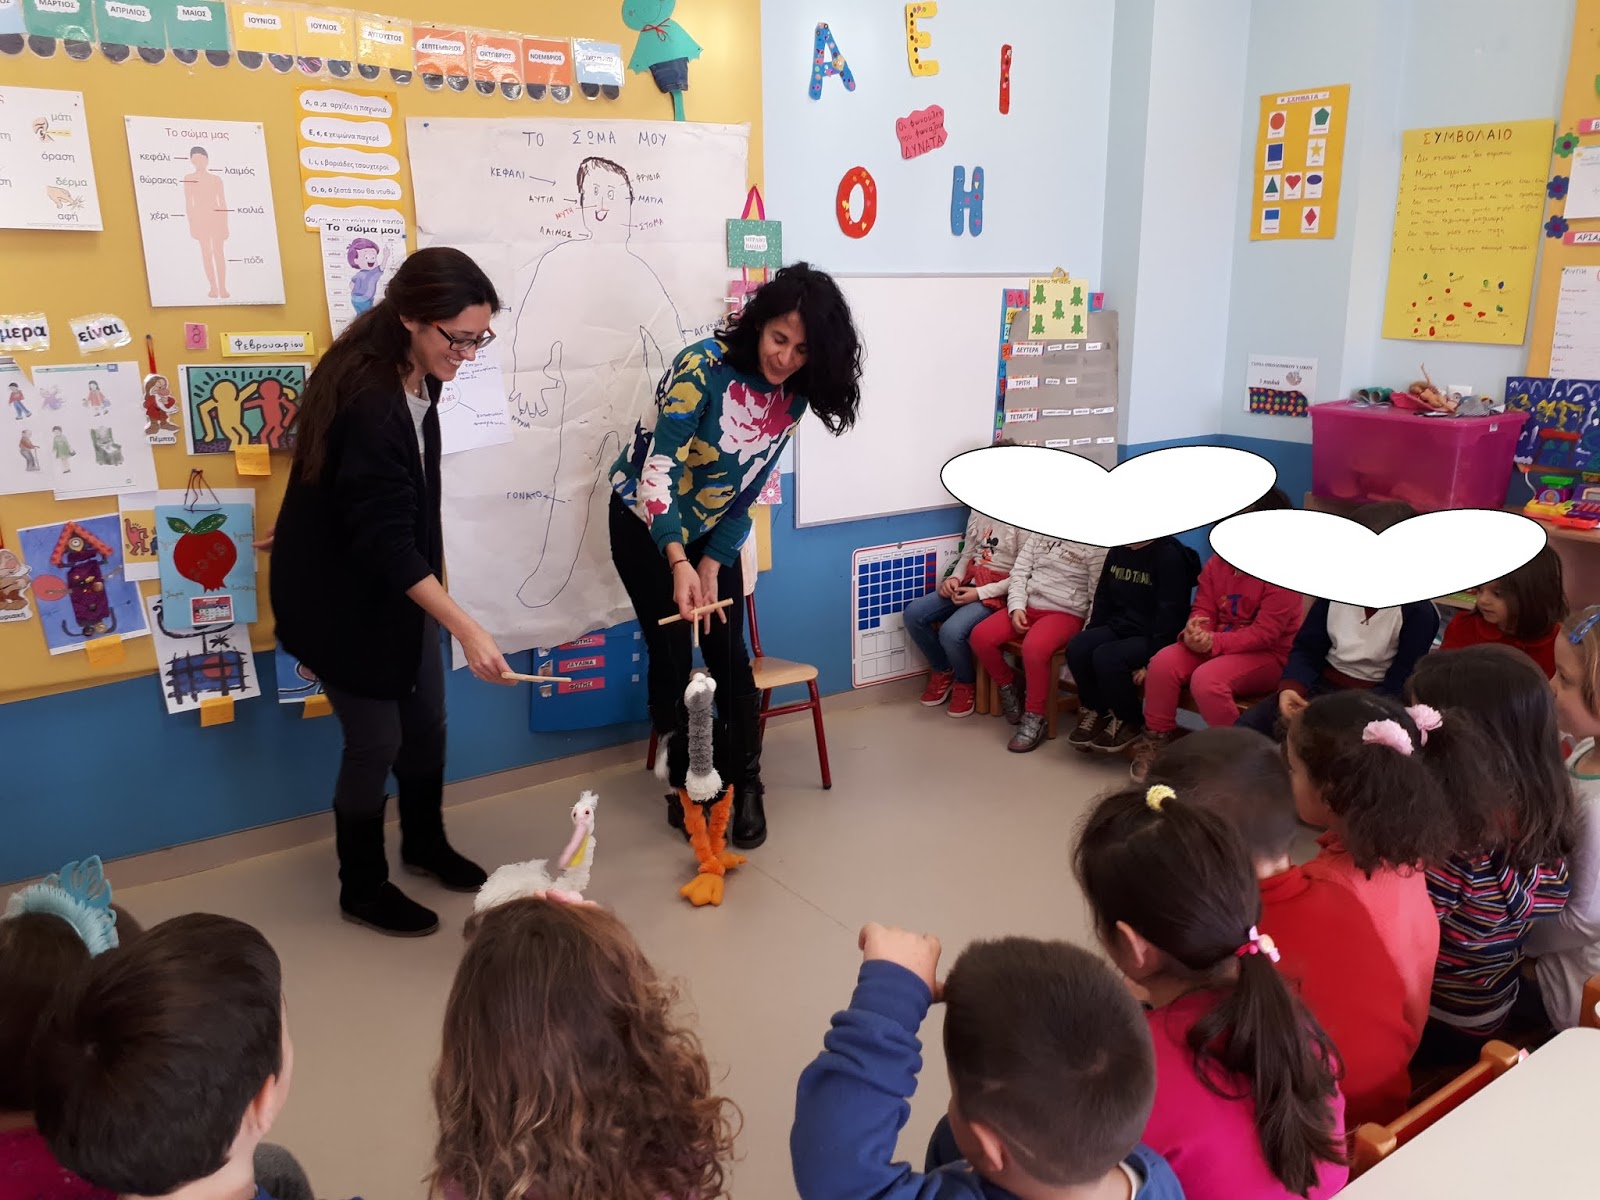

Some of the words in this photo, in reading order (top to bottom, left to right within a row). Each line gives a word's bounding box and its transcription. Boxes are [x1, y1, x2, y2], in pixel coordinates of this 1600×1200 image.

[110, 6, 147, 17] ΑΠΡΙΛΙΟΣ
[182, 9, 207, 17] ΜΑΙΟΣ
[248, 17, 277, 26] ΙΟΥΝΙΟΣ
[310, 22, 338, 32] ΙΟΥΛΙΟΣ
[530, 53, 562, 62] ΝΟΕΜΒΡΙΟΣ
[51, 113, 72, 122] μάτι
[165, 127, 178, 137] Το
[181, 129, 208, 139] σώμα
[211, 131, 229, 141] μας
[522, 131, 545, 147] ΤΟ
[638, 131, 667, 147] ΜΟΥ
[1423, 128, 1512, 145] ΣΥΜΒΟΛΑΙΟ
[904, 135, 944, 159] ΔΥΝΑΤΑ
[41, 152, 75, 163] όραση
[139, 152, 171, 162] κεφάλι
[224, 166, 255, 176] λαιμός
[490, 166, 526, 179] ΚΕΦΑΛΙ
[55, 177, 87, 188] δέρμα
[139, 175, 177, 186] θώρακας
[528, 195, 554, 203] ΑΥΤΙΑ
[237, 206, 264, 214] κοιλιά
[57, 212, 79, 222] αφή
[150, 211, 169, 220] χέρι
[346, 224, 378, 234] σώμα
[381, 227, 401, 235] μου
[638, 219, 664, 231] ΣΤΟΜΑ
[539, 226, 573, 238] ΛΑΙΜΟΣ
[243, 256, 264, 264] πόδι
[78, 323, 122, 342] είναι
[1009, 412, 1034, 420] ΤΕΤΑΡΤΗ
[506, 491, 543, 500] ΓΟΝΑΤΟ
